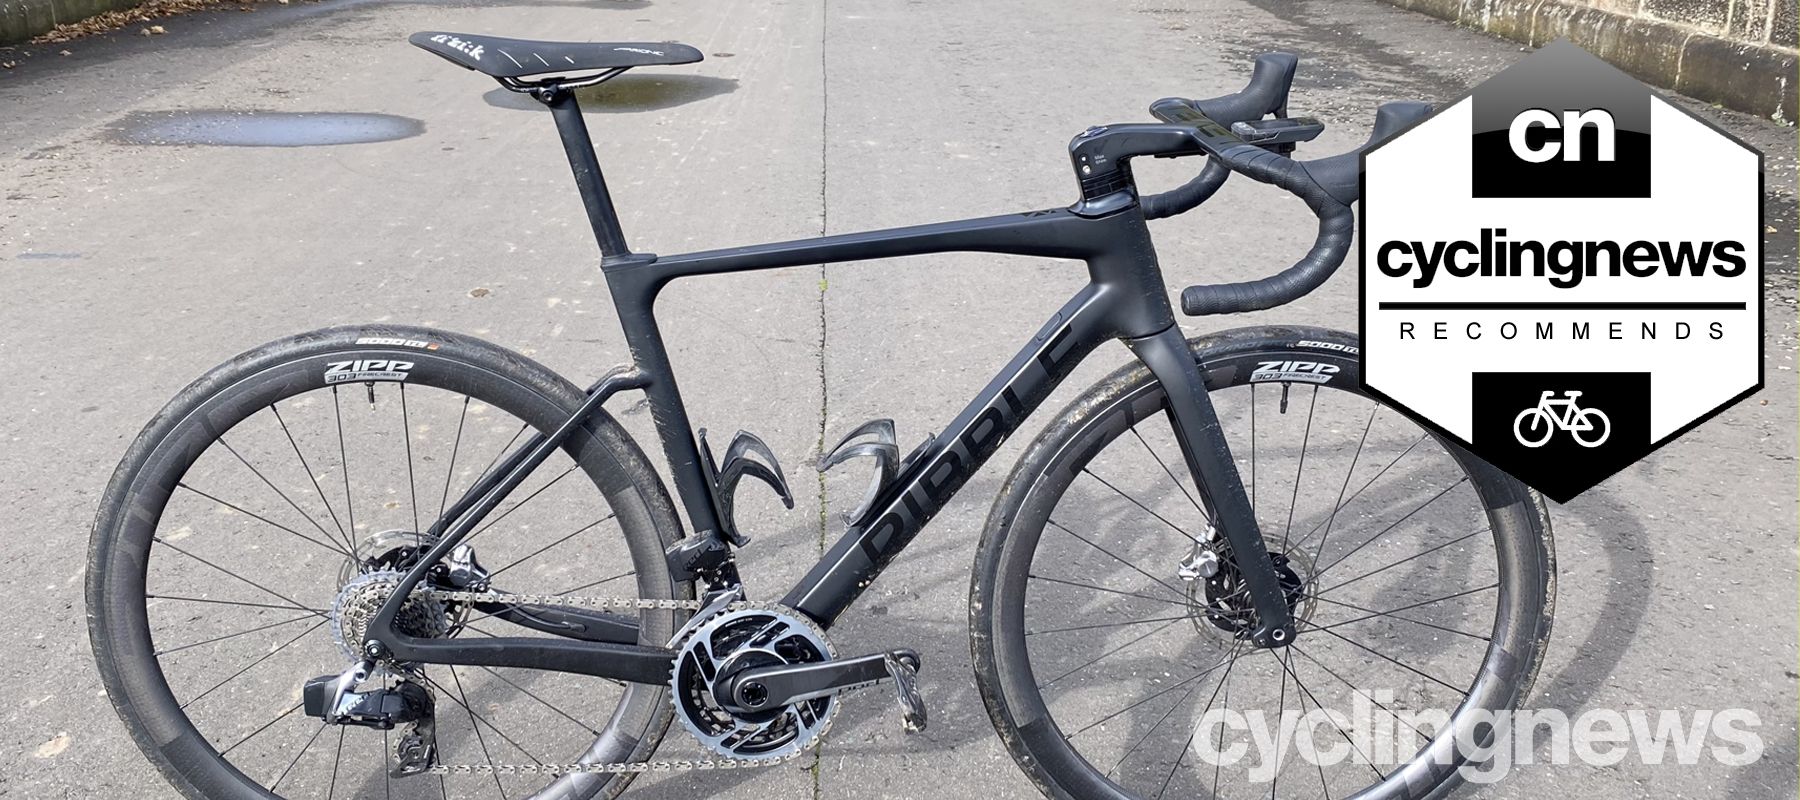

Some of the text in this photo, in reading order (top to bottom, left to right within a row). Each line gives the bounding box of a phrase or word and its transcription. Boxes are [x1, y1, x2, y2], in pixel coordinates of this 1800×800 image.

[1296, 340, 1344, 352] 5000
[325, 360, 415, 373] ZIPP
[1253, 361, 1340, 374] ZIPP
[327, 373, 356, 383] 303
